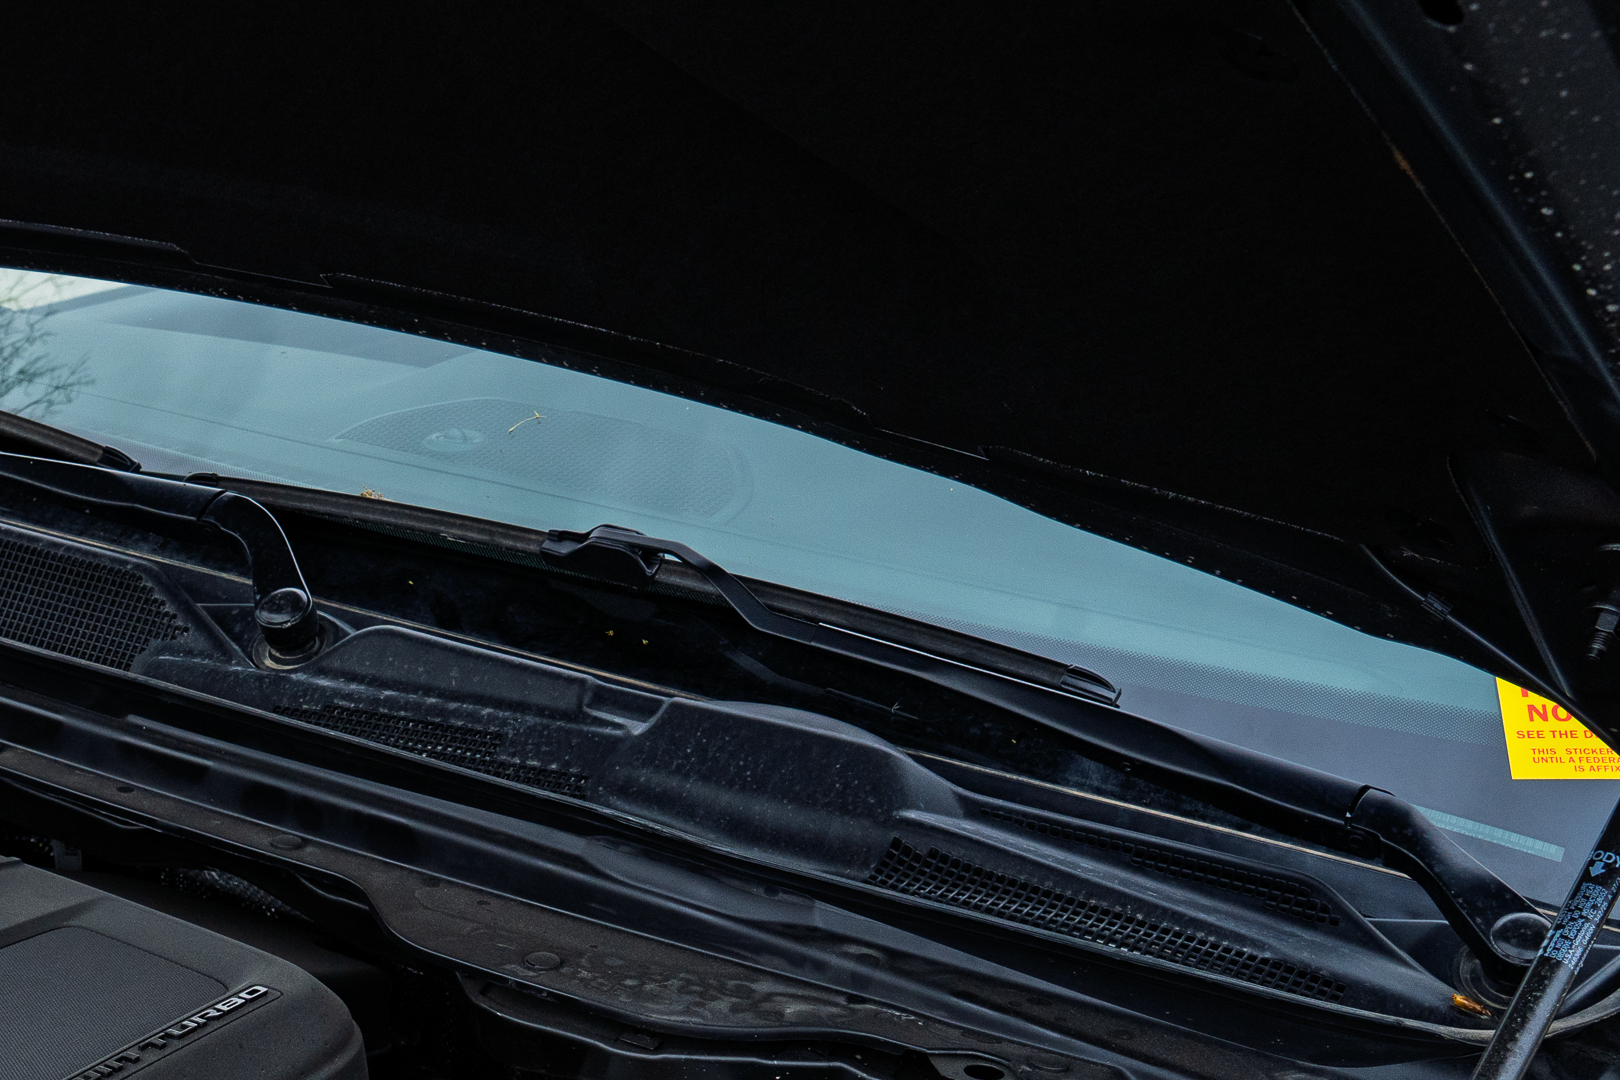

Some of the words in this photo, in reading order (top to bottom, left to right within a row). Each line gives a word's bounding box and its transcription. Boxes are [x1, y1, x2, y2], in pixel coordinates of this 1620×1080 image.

[1516, 730, 1546, 739] SEE
[1550, 730, 1579, 739] THE
[1531, 747, 1557, 755] THIS
[1565, 747, 1614, 755] STICKER
[1533, 756, 1565, 764] UNTIL
[1568, 756, 1576, 764] A
[1588, 850, 1620, 868] ODY
[138, 985, 269, 1051] TURBO
